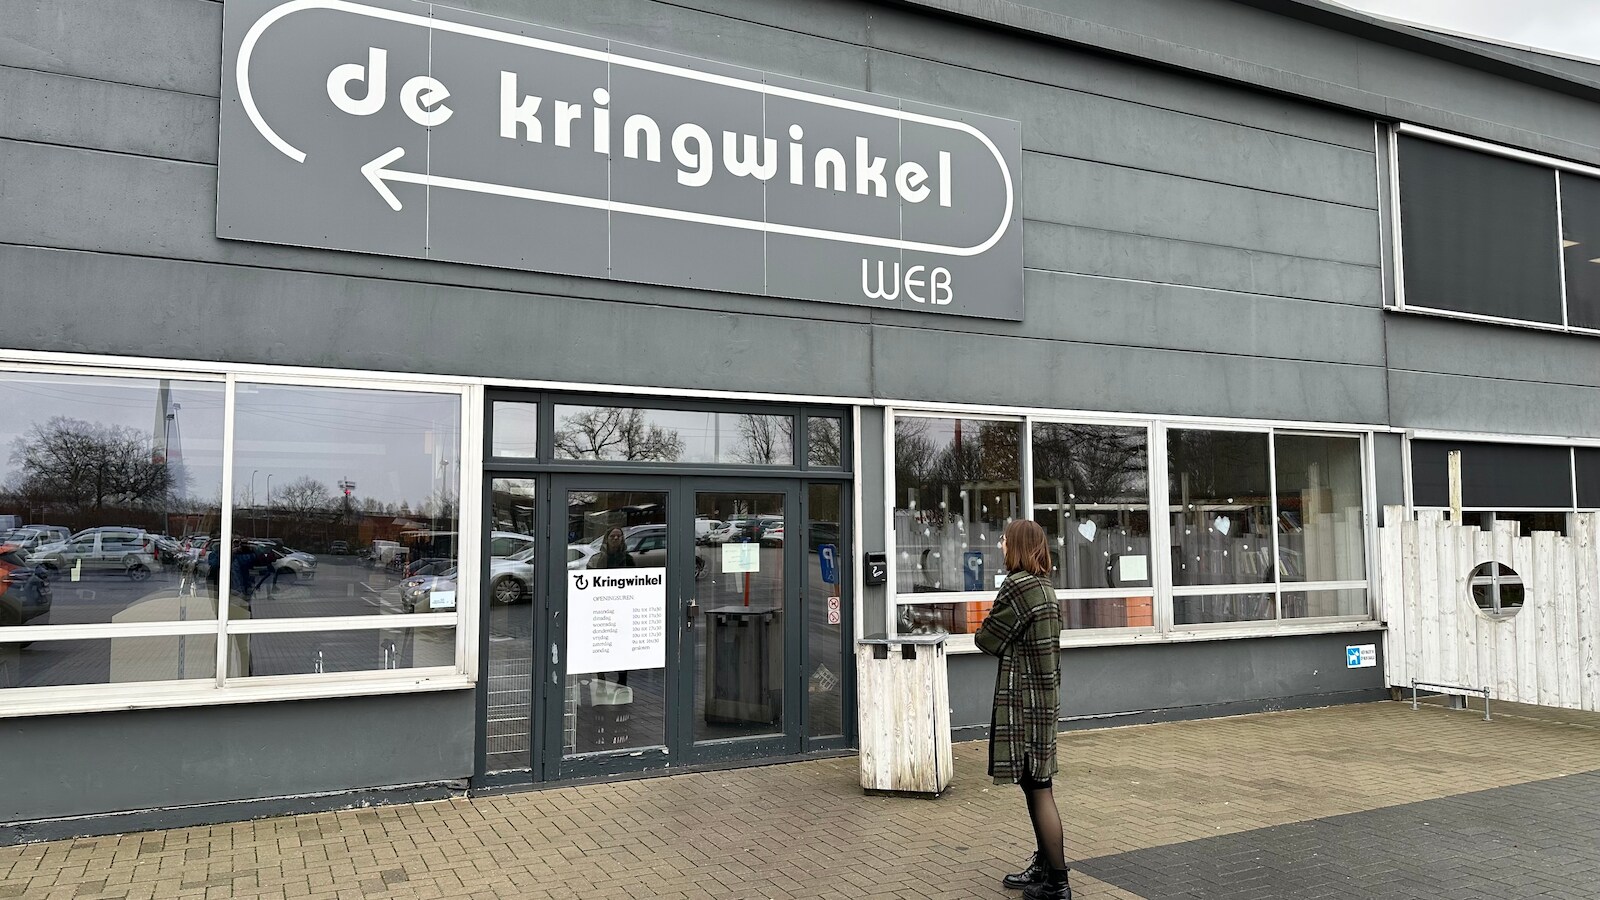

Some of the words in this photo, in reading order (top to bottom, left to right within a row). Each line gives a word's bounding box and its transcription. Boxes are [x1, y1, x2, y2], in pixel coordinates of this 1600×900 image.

[326, 46, 454, 127] de
[499, 70, 951, 208] kringwinkel
[862, 258, 954, 306] WEB
[593, 574, 662, 589] Kringwinkel
